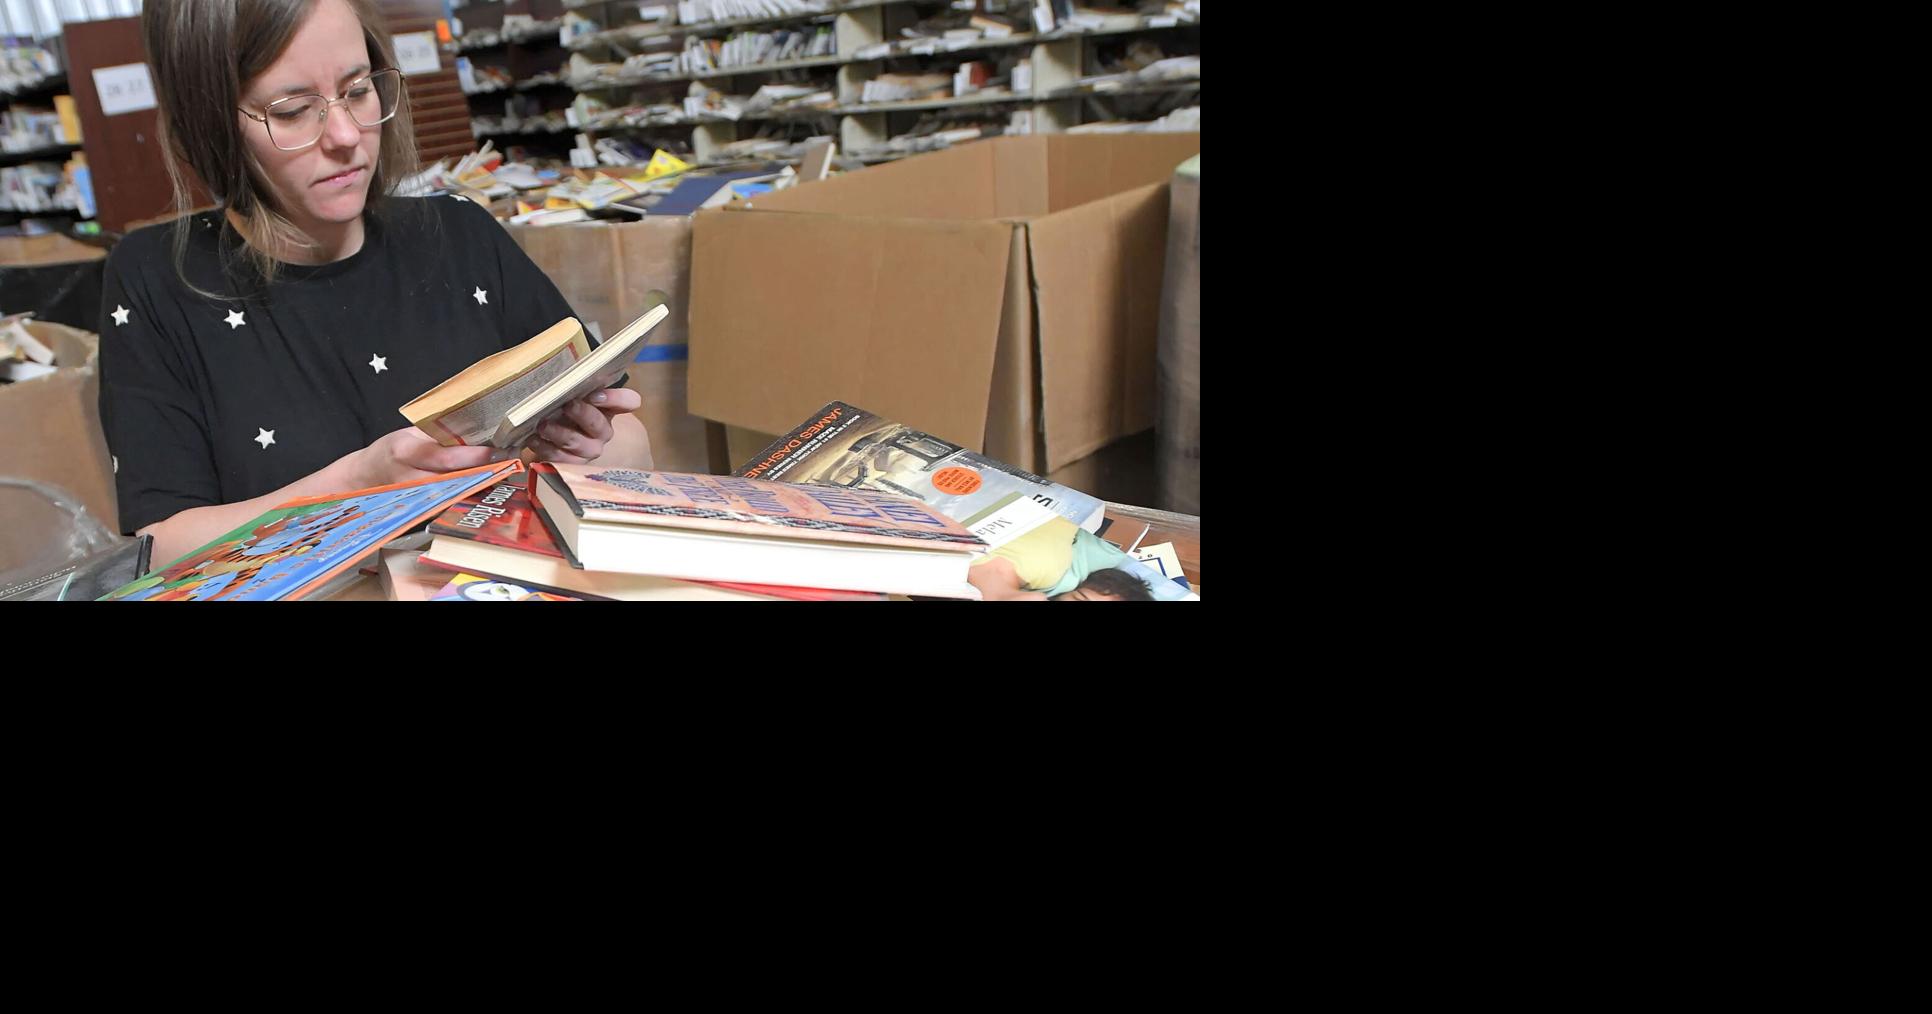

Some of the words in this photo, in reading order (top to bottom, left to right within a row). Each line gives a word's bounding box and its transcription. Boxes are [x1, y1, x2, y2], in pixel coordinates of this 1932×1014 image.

[800, 408, 842, 438] JAMES
[846, 415, 860, 425] BOOK
[815, 426, 835, 440] MAZE
[827, 431, 839, 439] THE
[790, 438, 818, 459] RUNNER
[810, 442, 822, 451] NEW
[744, 440, 801, 479] DASHNE
[798, 450, 811, 461] YORK
[773, 457, 792, 471] SERIES
[782, 460, 798, 473] TIMES
[482, 484, 526, 506] James
[457, 504, 506, 529] Risen
[975, 517, 1013, 536] Mela
